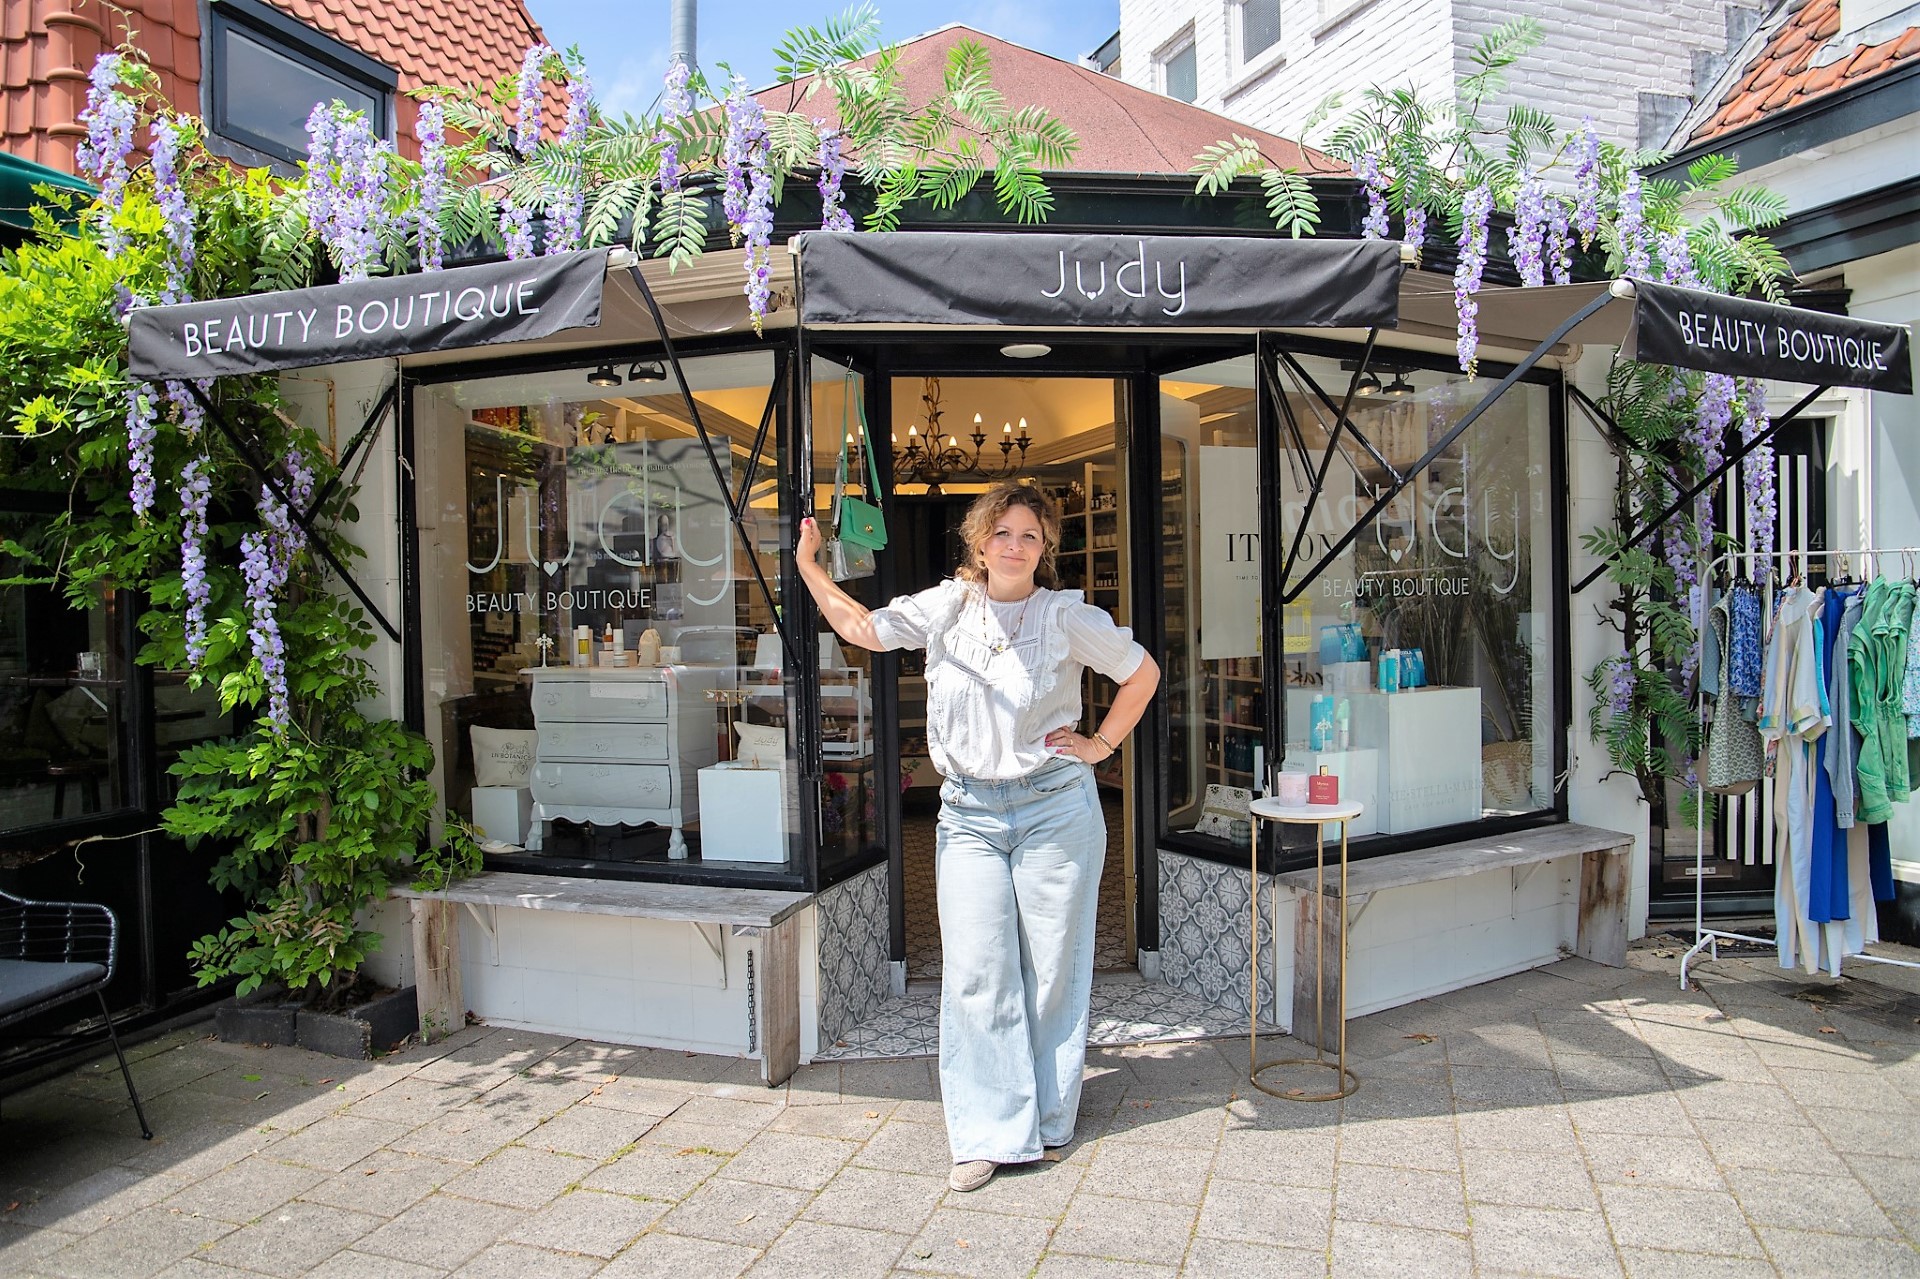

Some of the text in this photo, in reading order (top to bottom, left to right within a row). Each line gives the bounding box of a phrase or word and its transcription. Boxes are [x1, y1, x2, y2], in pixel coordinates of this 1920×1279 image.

[1041, 241, 1186, 316] Judy
[184, 278, 540, 357] BEAUTY BOUTIQUE
[1679, 311, 1888, 371] BEAUTY BOUTIQUE
[648, 463, 672, 472] nature
[465, 438, 731, 606] Judy
[1810, 528, 1824, 549] 4
[466, 588, 652, 613] BEAUTY BOUTIQUE
[1323, 577, 1470, 598] BEAUTY BOUTIQUE
